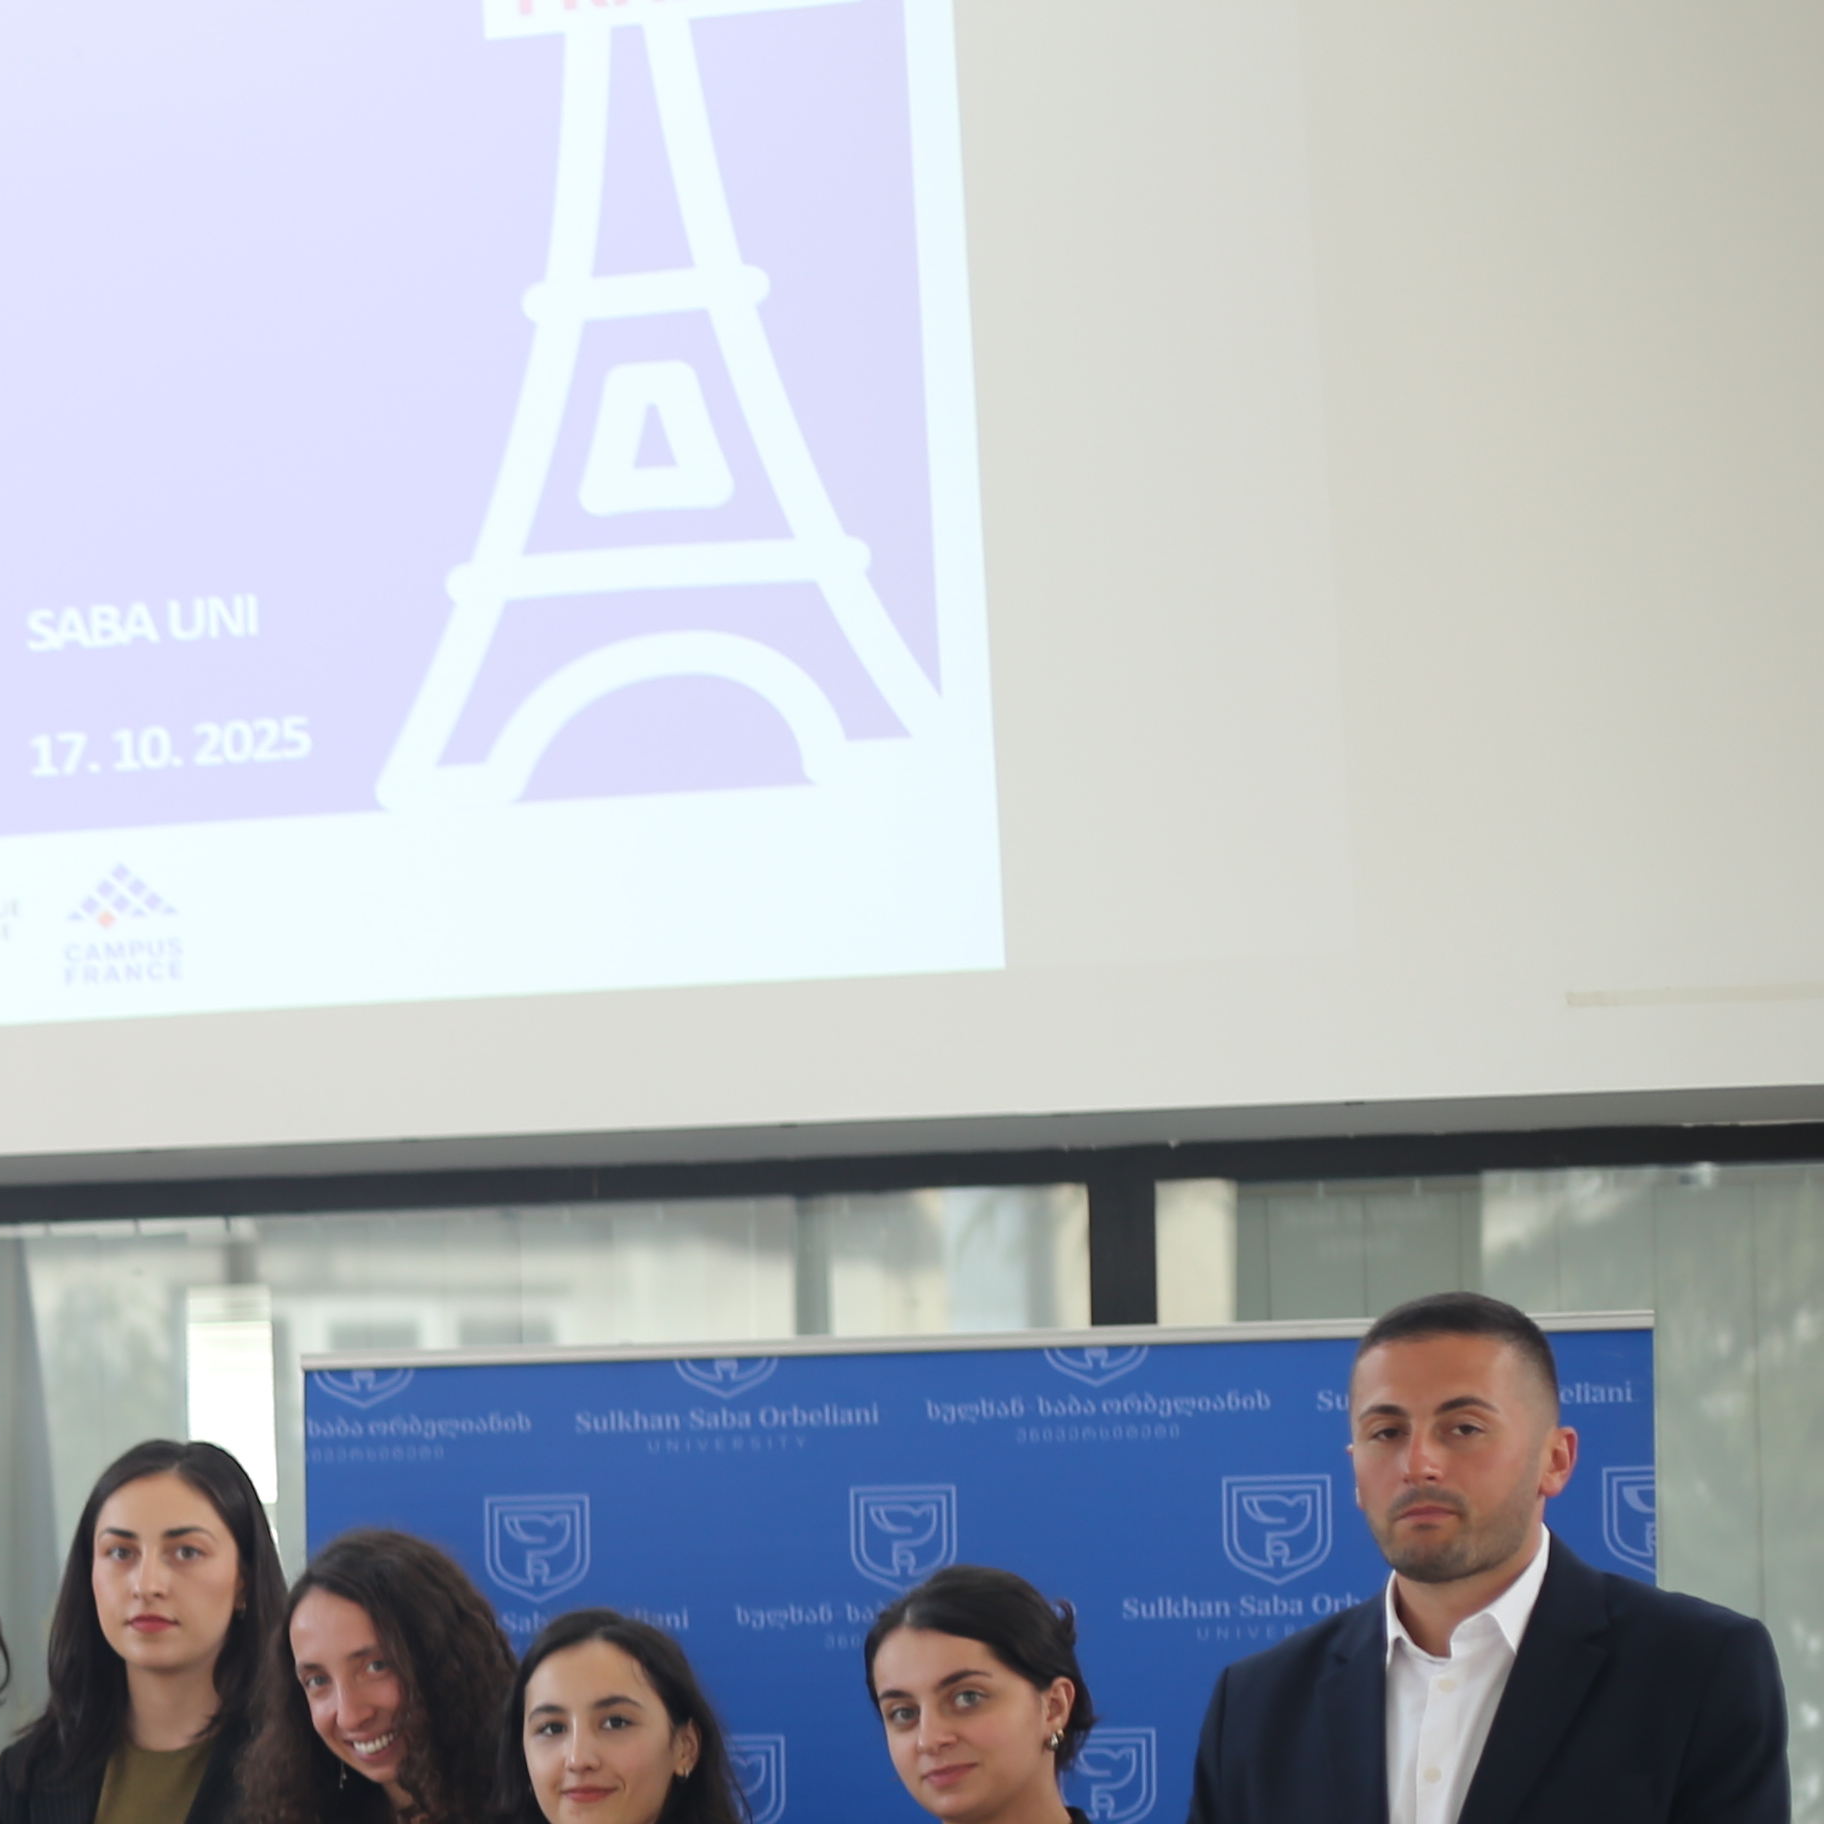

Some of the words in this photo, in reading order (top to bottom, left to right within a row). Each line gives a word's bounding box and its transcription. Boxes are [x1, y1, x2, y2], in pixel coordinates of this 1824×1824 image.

[25, 600, 160, 652] SABA
[167, 593, 260, 642] UNI
[27, 732, 100, 777] 17.
[112, 726, 182, 771] 10.
[193, 715, 313, 766] 2025
[63, 936, 185, 962] CAMPUS
[63, 960, 185, 986] FRANCE
[759, 1402, 880, 1428] Orbeliani
[647, 1436, 807, 1455] UNIVERSITY
